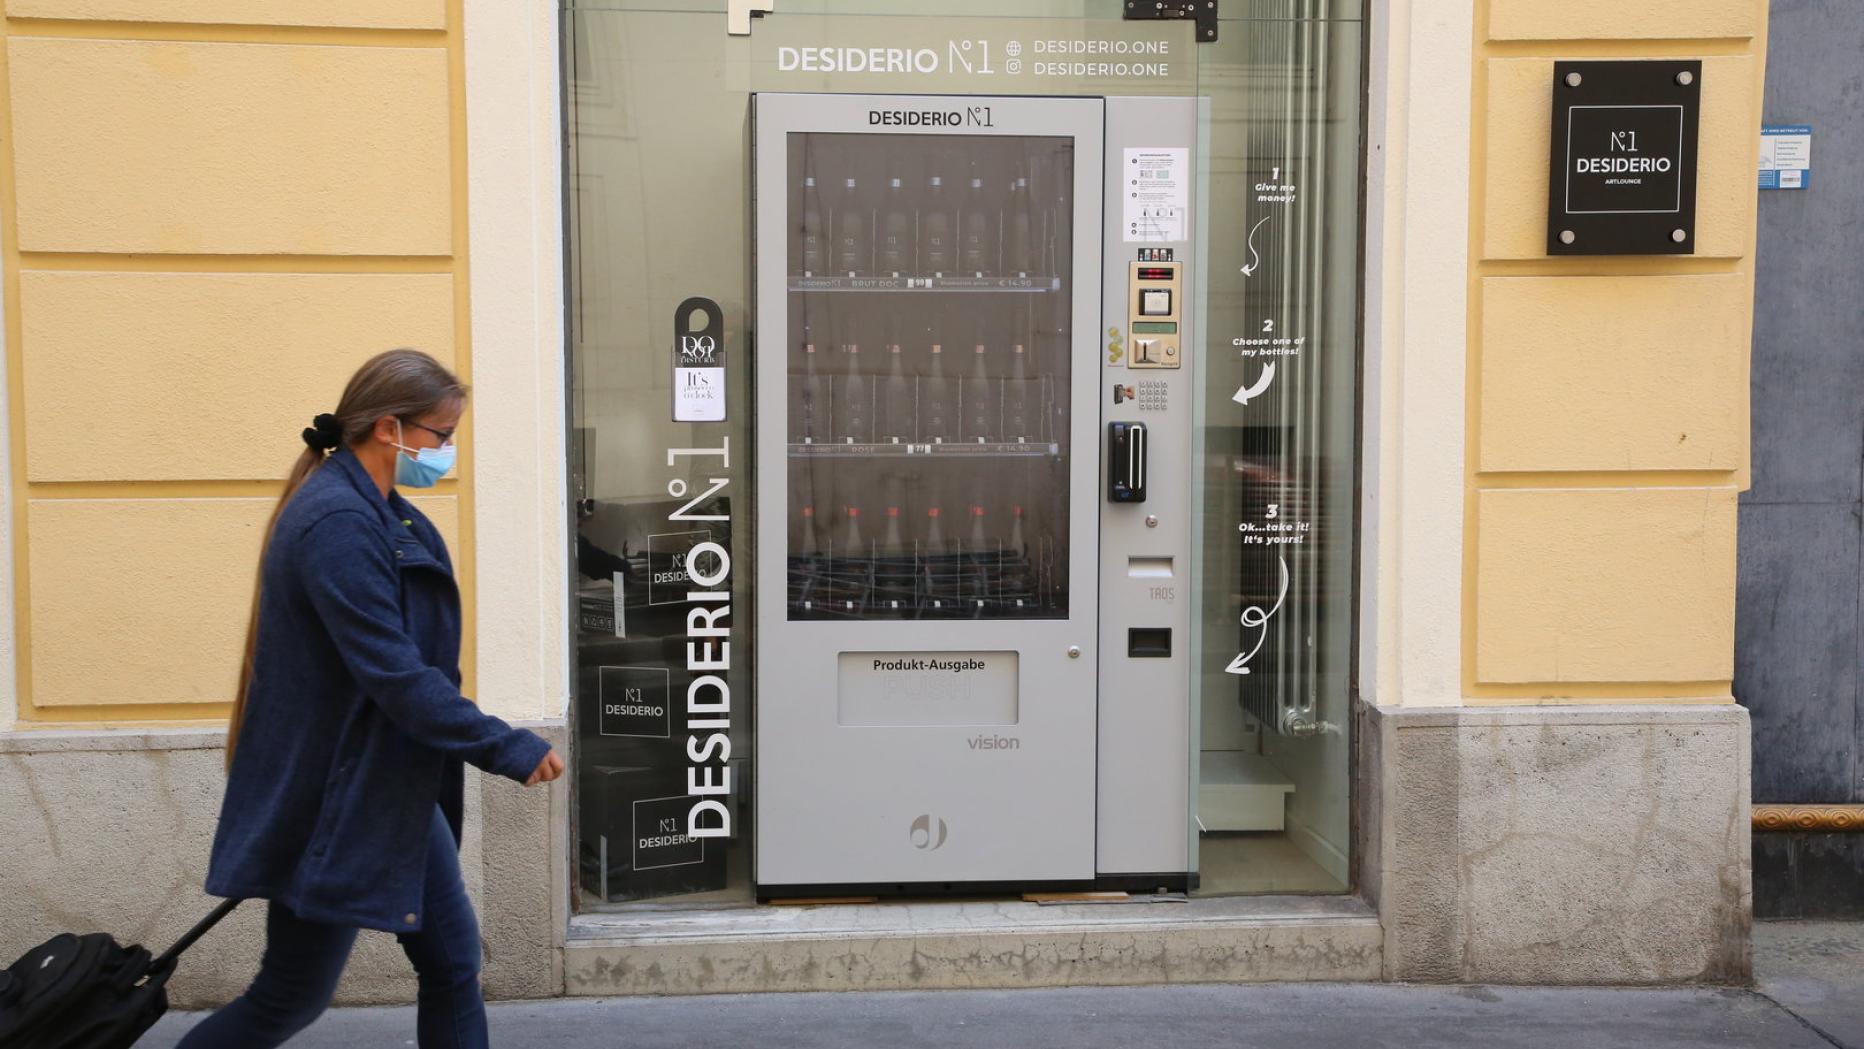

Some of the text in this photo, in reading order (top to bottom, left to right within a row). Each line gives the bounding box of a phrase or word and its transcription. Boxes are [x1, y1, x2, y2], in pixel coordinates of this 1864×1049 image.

[1033, 40, 1169, 55] DESIDERIO.ONE
[778, 47, 938, 73] DESIDERIO
[1033, 62, 1169, 77] DESIDERIO.ONE
[868, 110, 963, 127] DESIDERIO
[1576, 158, 1671, 173] DESIDERIO
[1272, 167, 1279, 180] 1
[1255, 183, 1277, 191] Give
[1257, 195, 1296, 203] money!
[1262, 319, 1274, 332] 2
[1232, 338, 1269, 346] Choose
[1294, 336, 1305, 345] of
[1241, 347, 1299, 357] my bottles!
[1265, 504, 1278, 519] 3
[1265, 535, 1304, 545] yours!
[873, 658, 985, 672] Produkt-Ausgabe
[686, 541, 731, 838] DESIDERIO
[605, 704, 664, 717] DESIDERIO
[967, 734, 1020, 749] vision
